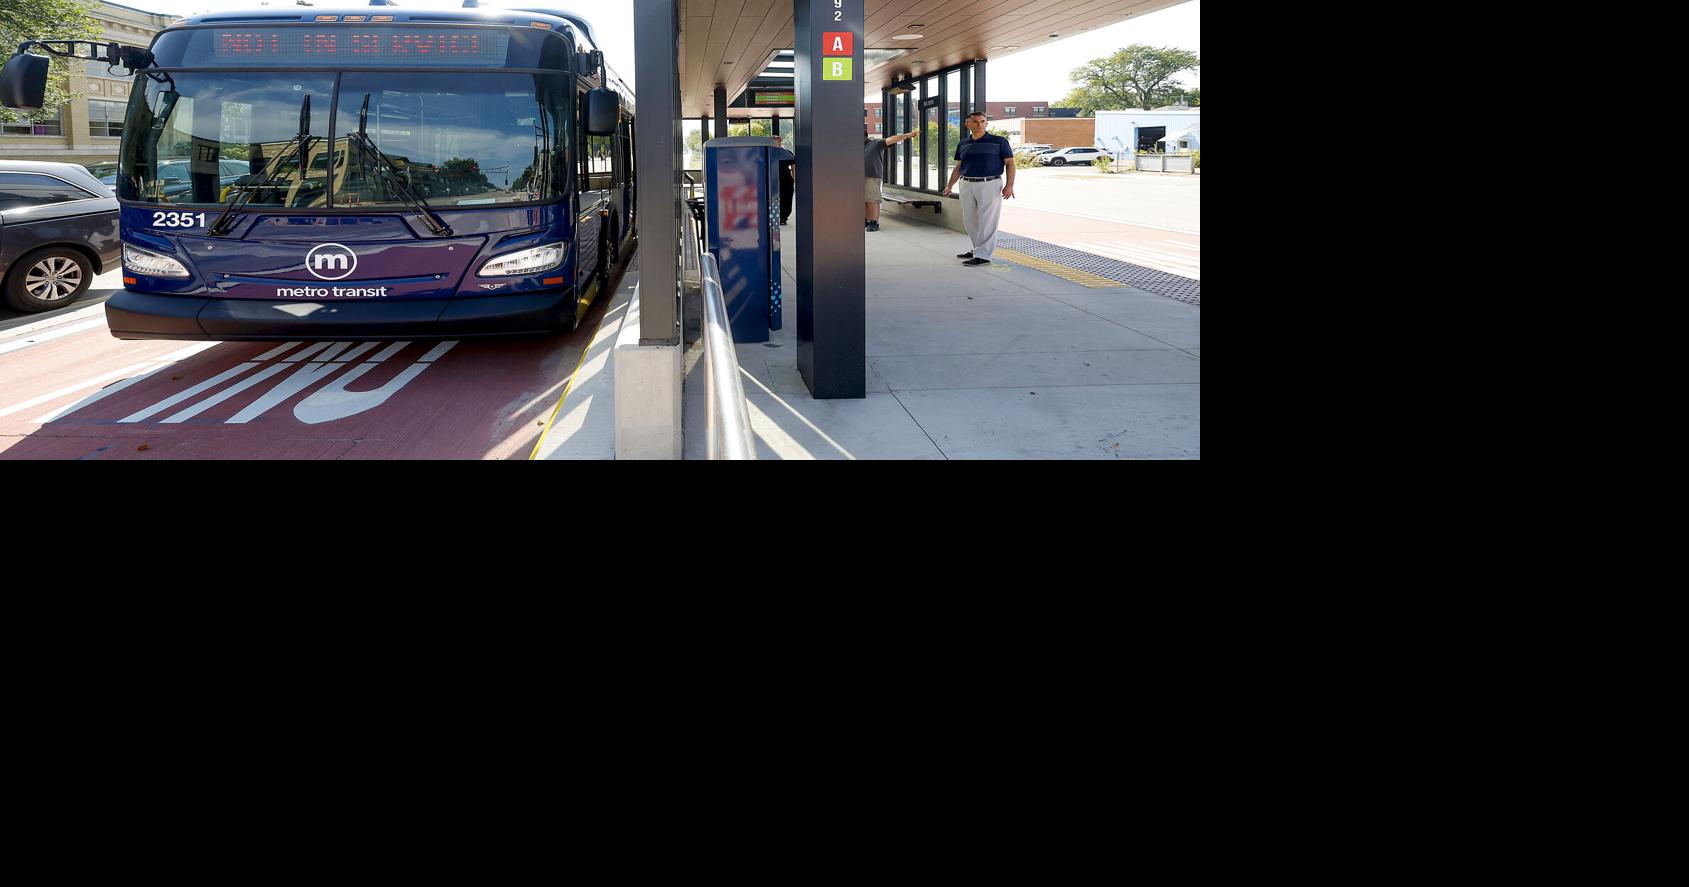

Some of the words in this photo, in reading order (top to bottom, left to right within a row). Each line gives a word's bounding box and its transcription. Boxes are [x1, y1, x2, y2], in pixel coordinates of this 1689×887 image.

[832, 36, 843, 51] A
[832, 61, 843, 77] B
[152, 211, 205, 228] 2351
[314, 252, 348, 270] m
[276, 285, 329, 298] metro
[331, 285, 388, 298] transit
